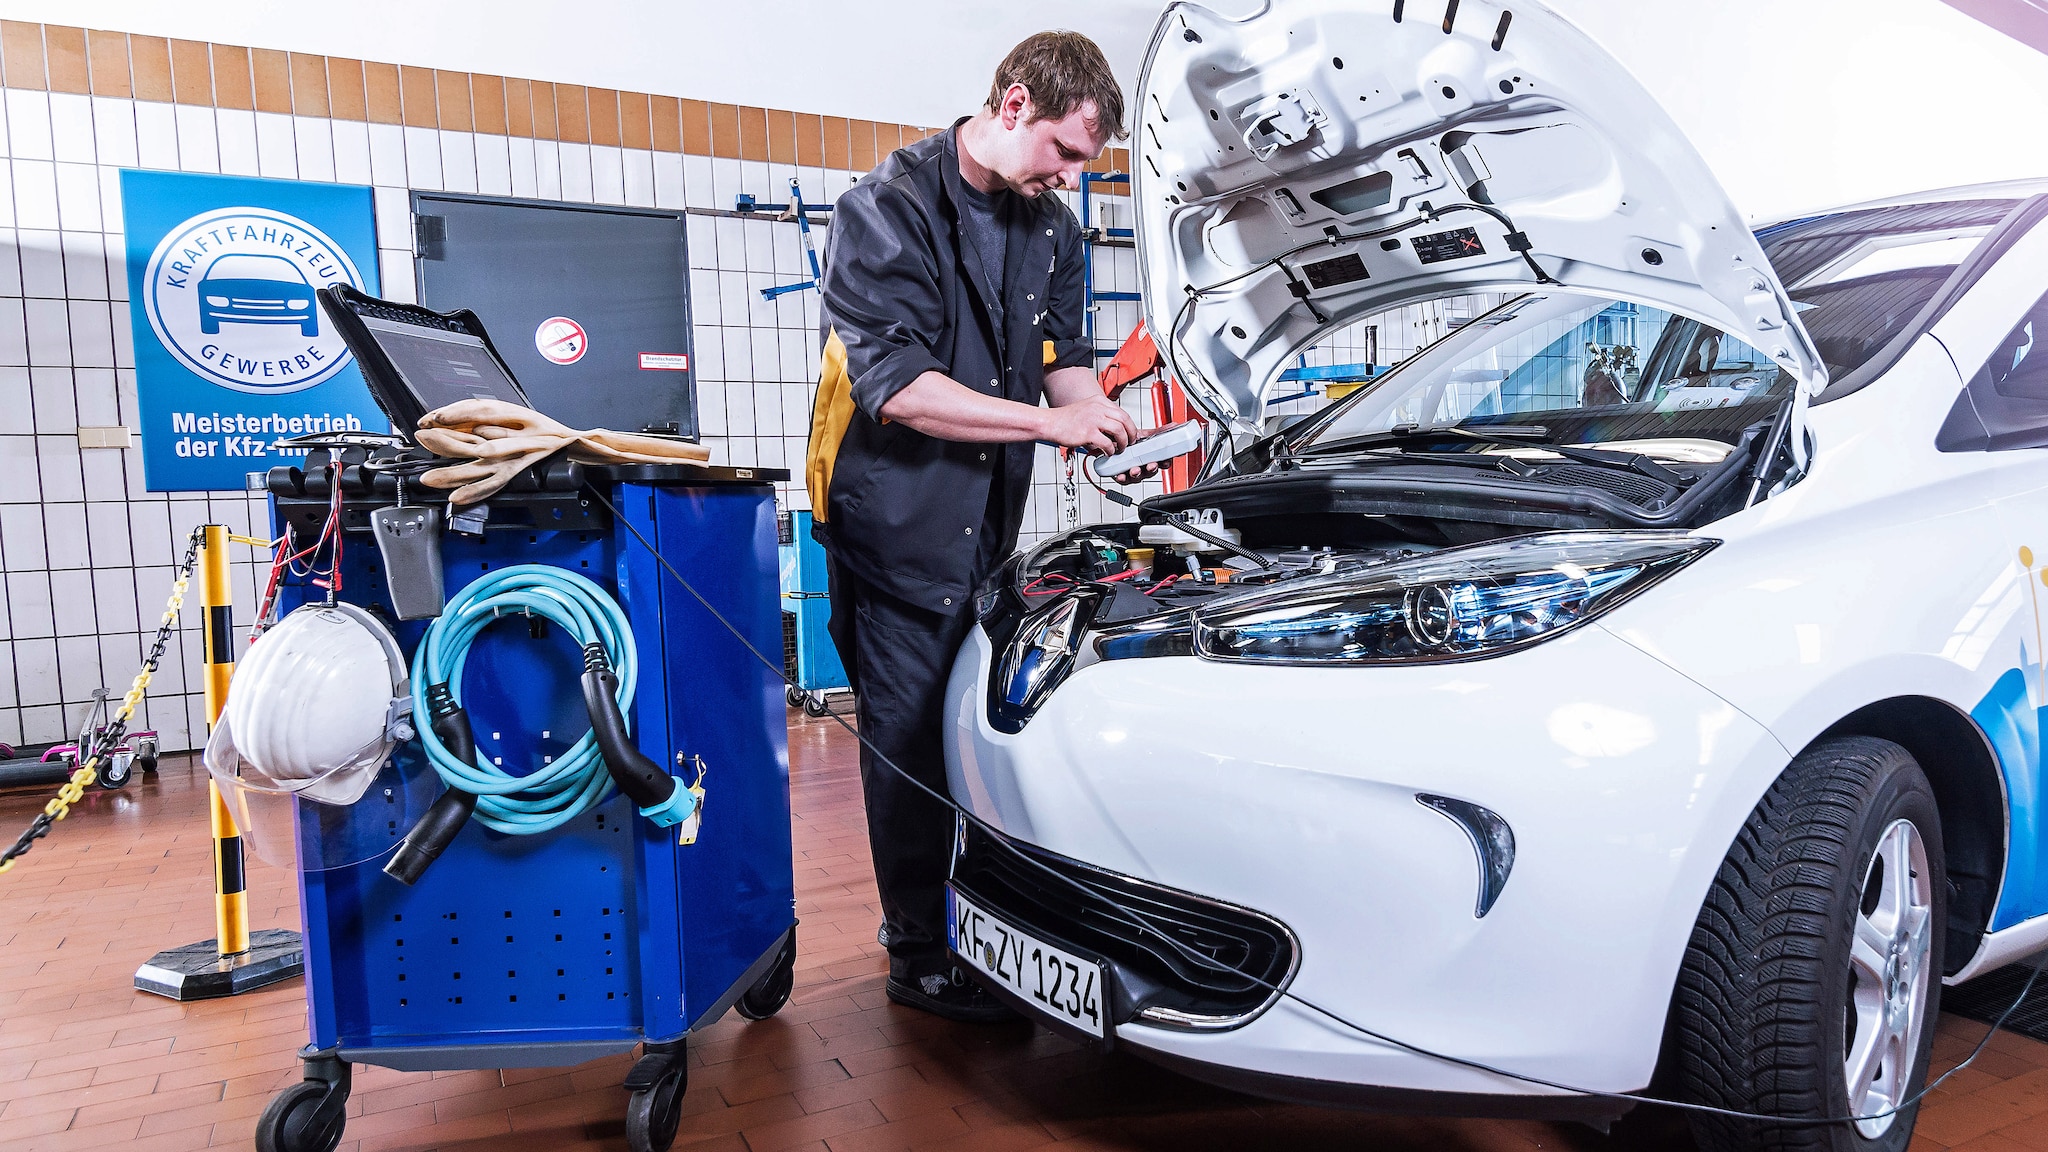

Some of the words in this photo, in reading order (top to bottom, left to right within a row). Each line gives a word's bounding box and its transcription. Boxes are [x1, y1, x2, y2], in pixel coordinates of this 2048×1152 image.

[167, 225, 340, 289] KRAFTFAHRZEU
[201, 344, 325, 377] GEWERBE
[172, 412, 361, 433] Meisterbetrieb
[175, 437, 218, 457] der
[958, 901, 985, 961] KF
[995, 925, 1024, 989] ZY
[1032, 948, 1099, 1027] 1234
